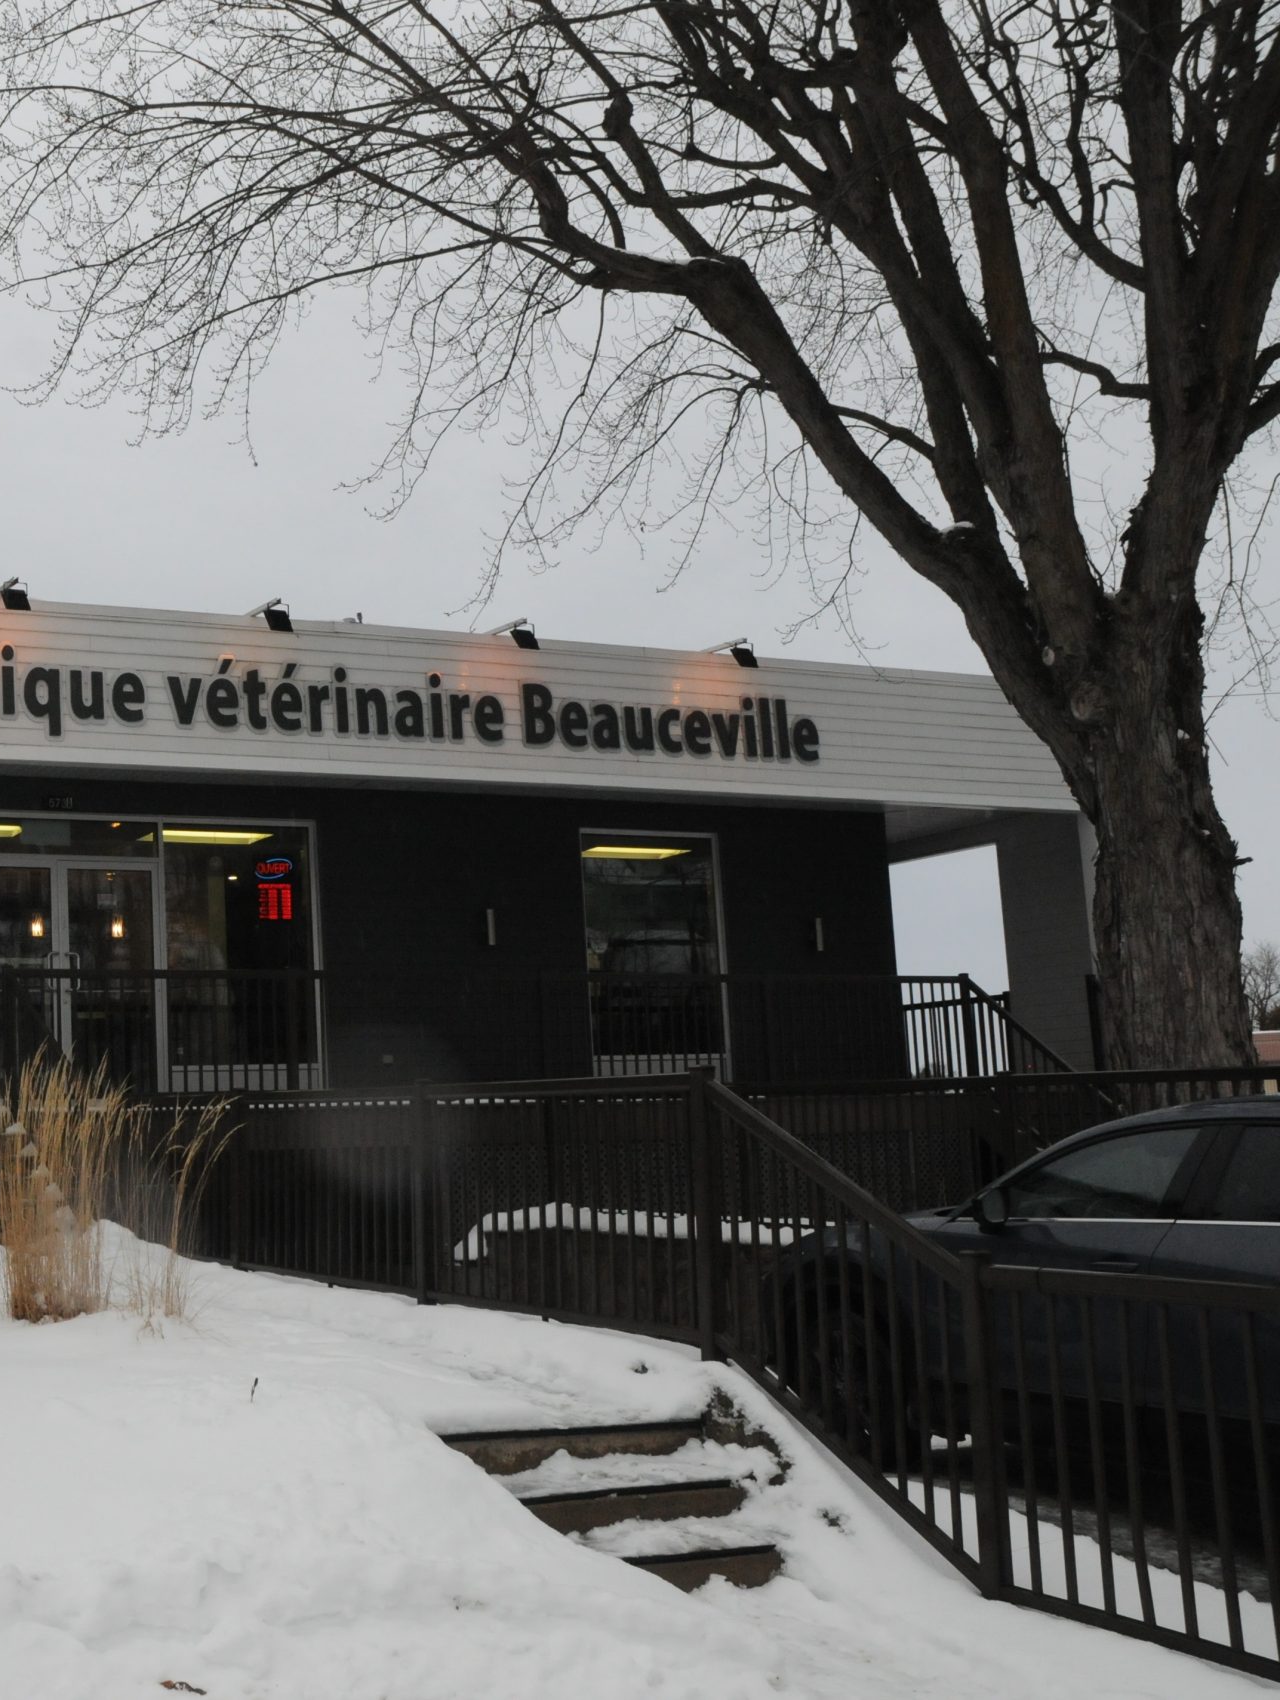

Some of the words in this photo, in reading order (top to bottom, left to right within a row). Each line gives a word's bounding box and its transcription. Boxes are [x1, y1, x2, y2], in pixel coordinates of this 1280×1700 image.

[167, 658, 505, 742] vétérinaire
[522, 683, 819, 761] Beauceville
[256, 862, 289, 874] OUVERT
